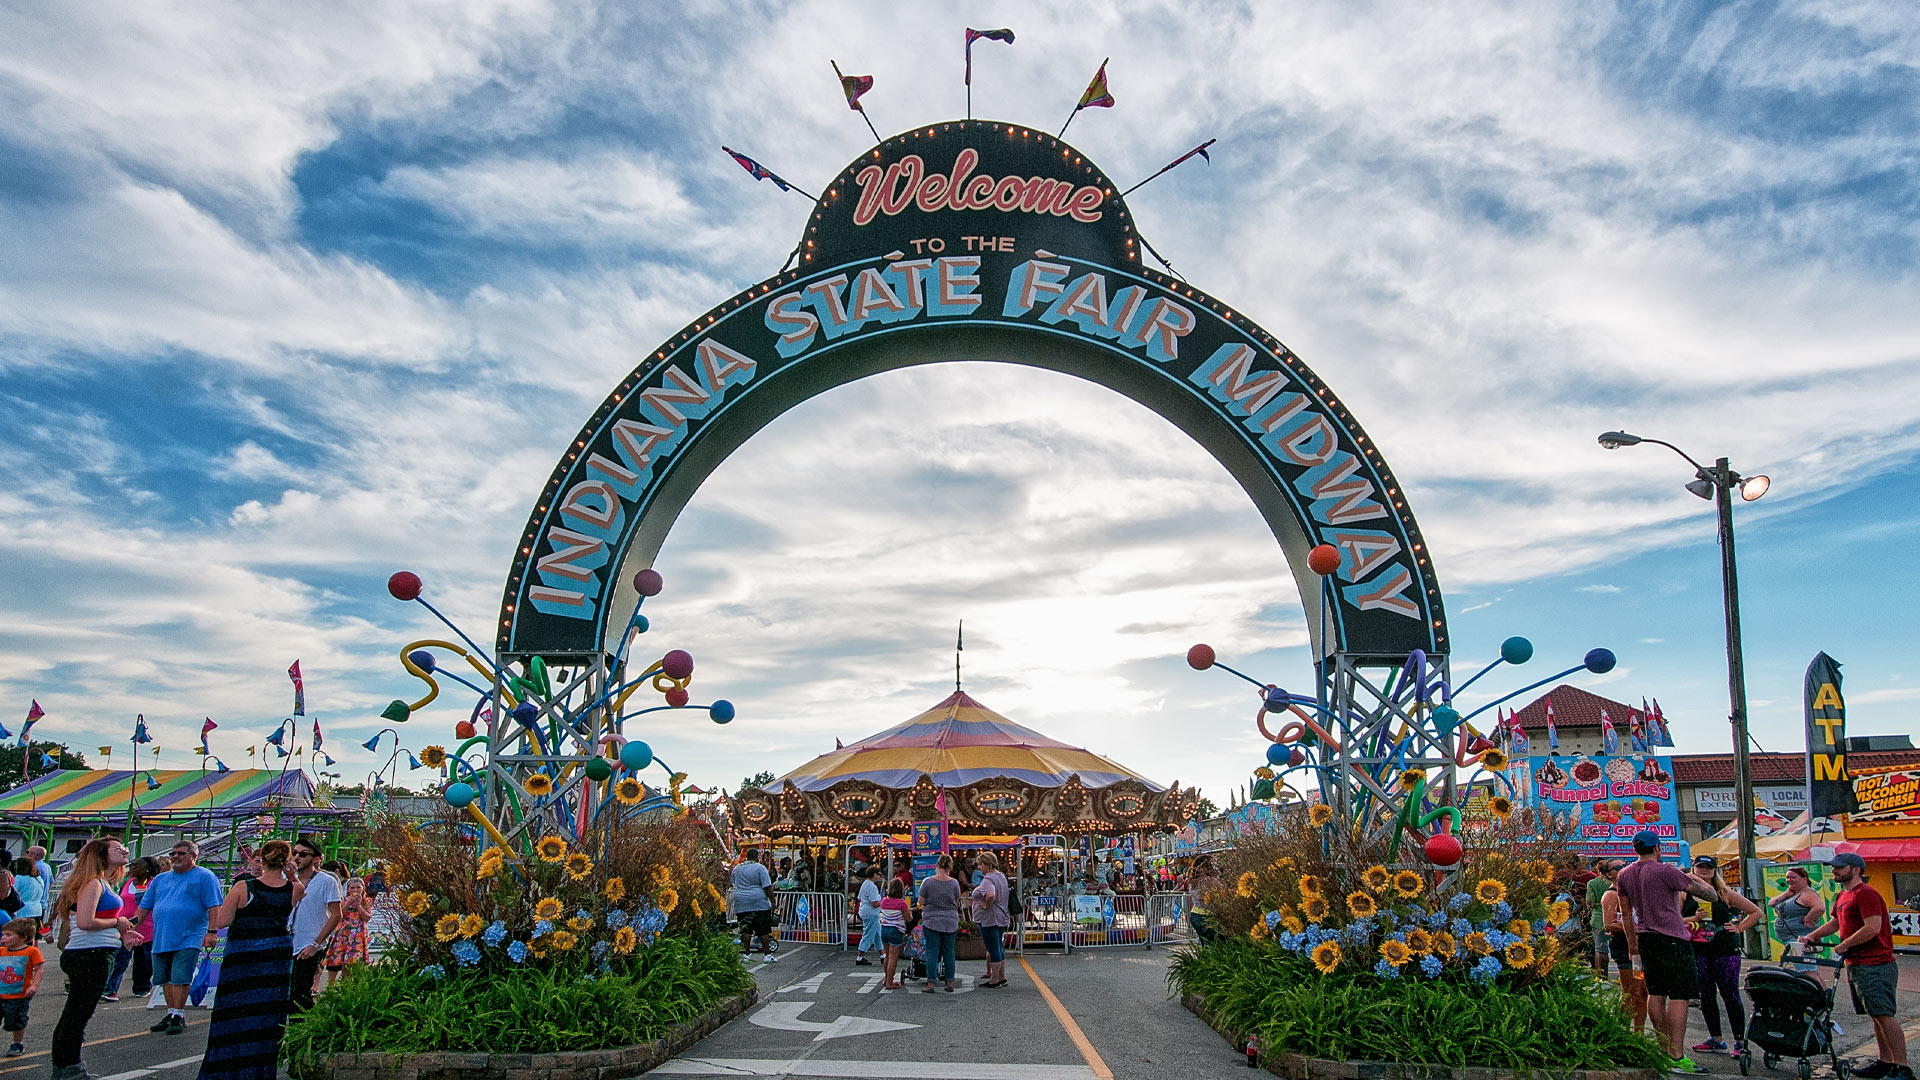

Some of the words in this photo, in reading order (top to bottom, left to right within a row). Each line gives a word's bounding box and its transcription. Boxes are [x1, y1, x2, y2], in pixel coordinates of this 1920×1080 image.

[854, 148, 1104, 225] Welcome
[909, 237, 946, 253] TO
[961, 236, 1015, 253] THE
[528, 338, 758, 620] INDIANA
[764, 255, 983, 358] STATE
[1003, 258, 1197, 362] FAIR
[1189, 342, 1421, 620] MIDWAY
[1813, 683, 1849, 780] ATM
[1539, 781, 1607, 802] Funnel
[1610, 780, 1669, 799] Cakes
[1857, 777, 1883, 792] HOT
[1772, 792, 1806, 800] LOCAL
[1872, 792, 1916, 811] CHEESE
[1621, 804, 1633, 815] &
[1582, 825, 1609, 837] ICE
